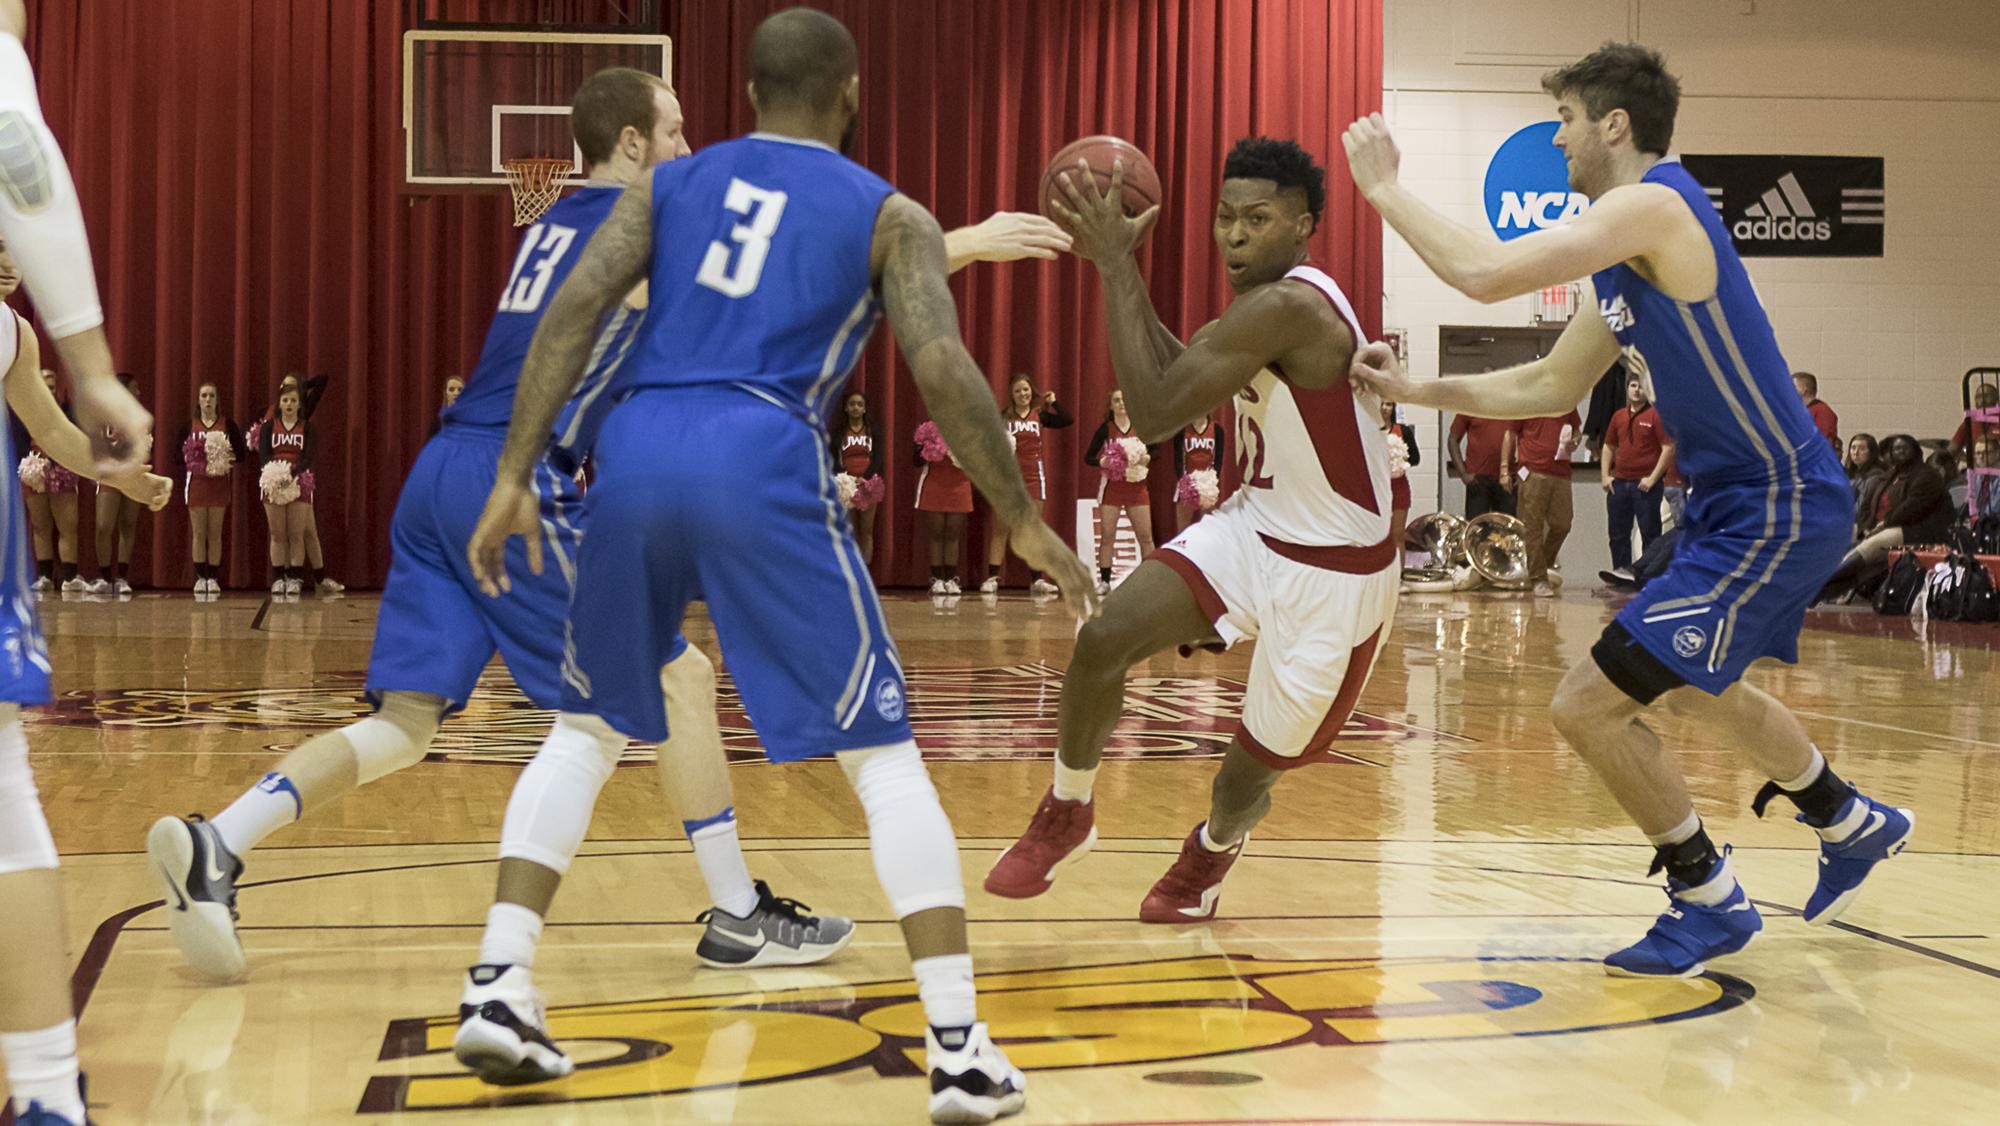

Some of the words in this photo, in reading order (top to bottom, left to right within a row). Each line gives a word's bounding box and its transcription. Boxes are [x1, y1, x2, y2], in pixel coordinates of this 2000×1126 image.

[694, 176, 789, 299] 3
[1733, 216, 1831, 240] adidas
[498, 223, 578, 313] 13
[1543, 284, 1568, 305] EXIT
[1008, 421, 1040, 437] UWA
[271, 433, 304, 450] UWA
[1184, 437, 1215, 454] UWA
